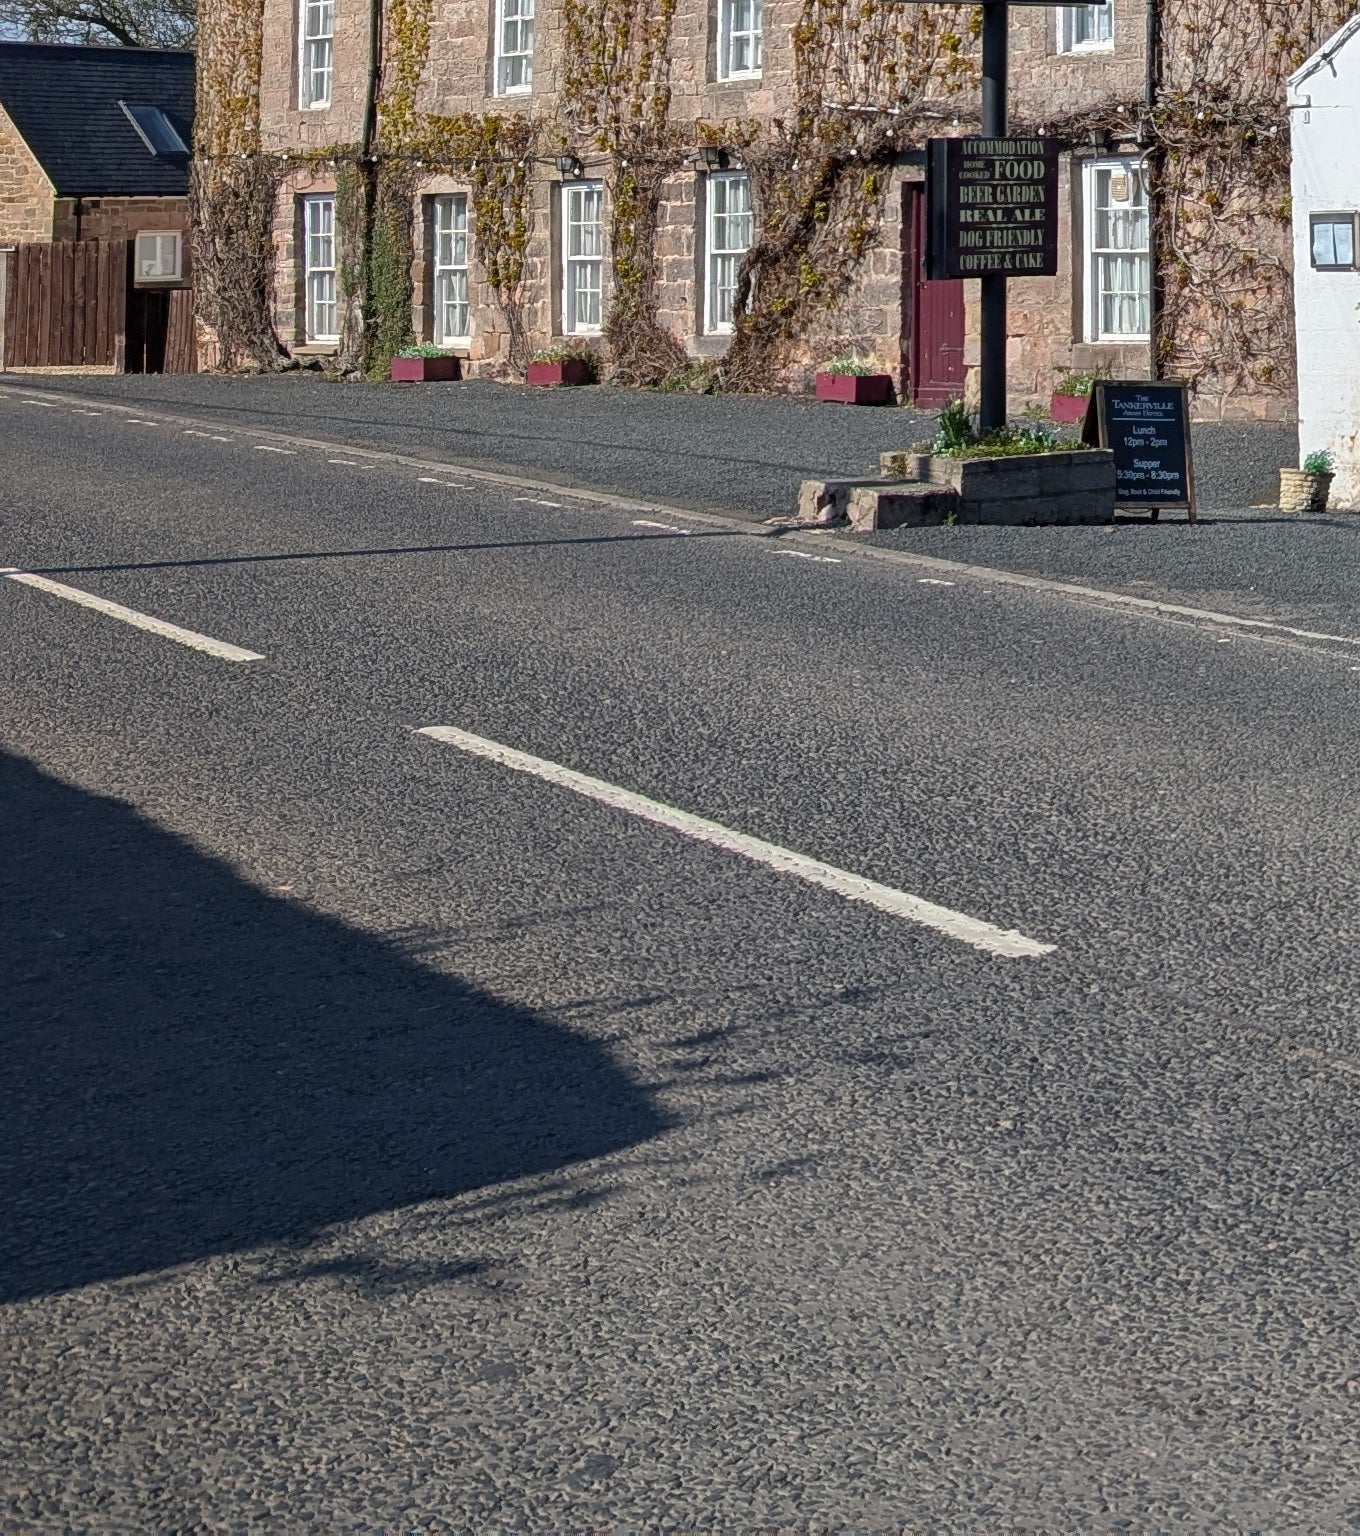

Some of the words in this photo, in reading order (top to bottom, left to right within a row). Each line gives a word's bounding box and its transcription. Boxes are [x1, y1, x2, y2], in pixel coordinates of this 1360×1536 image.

[961, 140, 1045, 155] ACCOMMODATION
[994, 160, 1046, 180] FOOD
[959, 185, 994, 203] BEER
[996, 185, 1046, 203] GARDEN
[959, 209, 1008, 223] REAL
[1011, 208, 1046, 221] ALE
[959, 230, 983, 247] DOG
[985, 228, 1046, 247] FRIENDLY
[959, 254, 1002, 270] COFFEE
[1003, 253, 1013, 269] &
[1015, 252, 1044, 268] CAKE
[1132, 425, 1156, 435] Lunch
[1123, 436, 1144, 447] 12pm
[1150, 436, 1168, 448] 2pm
[1133, 458, 1160, 470] Supper
